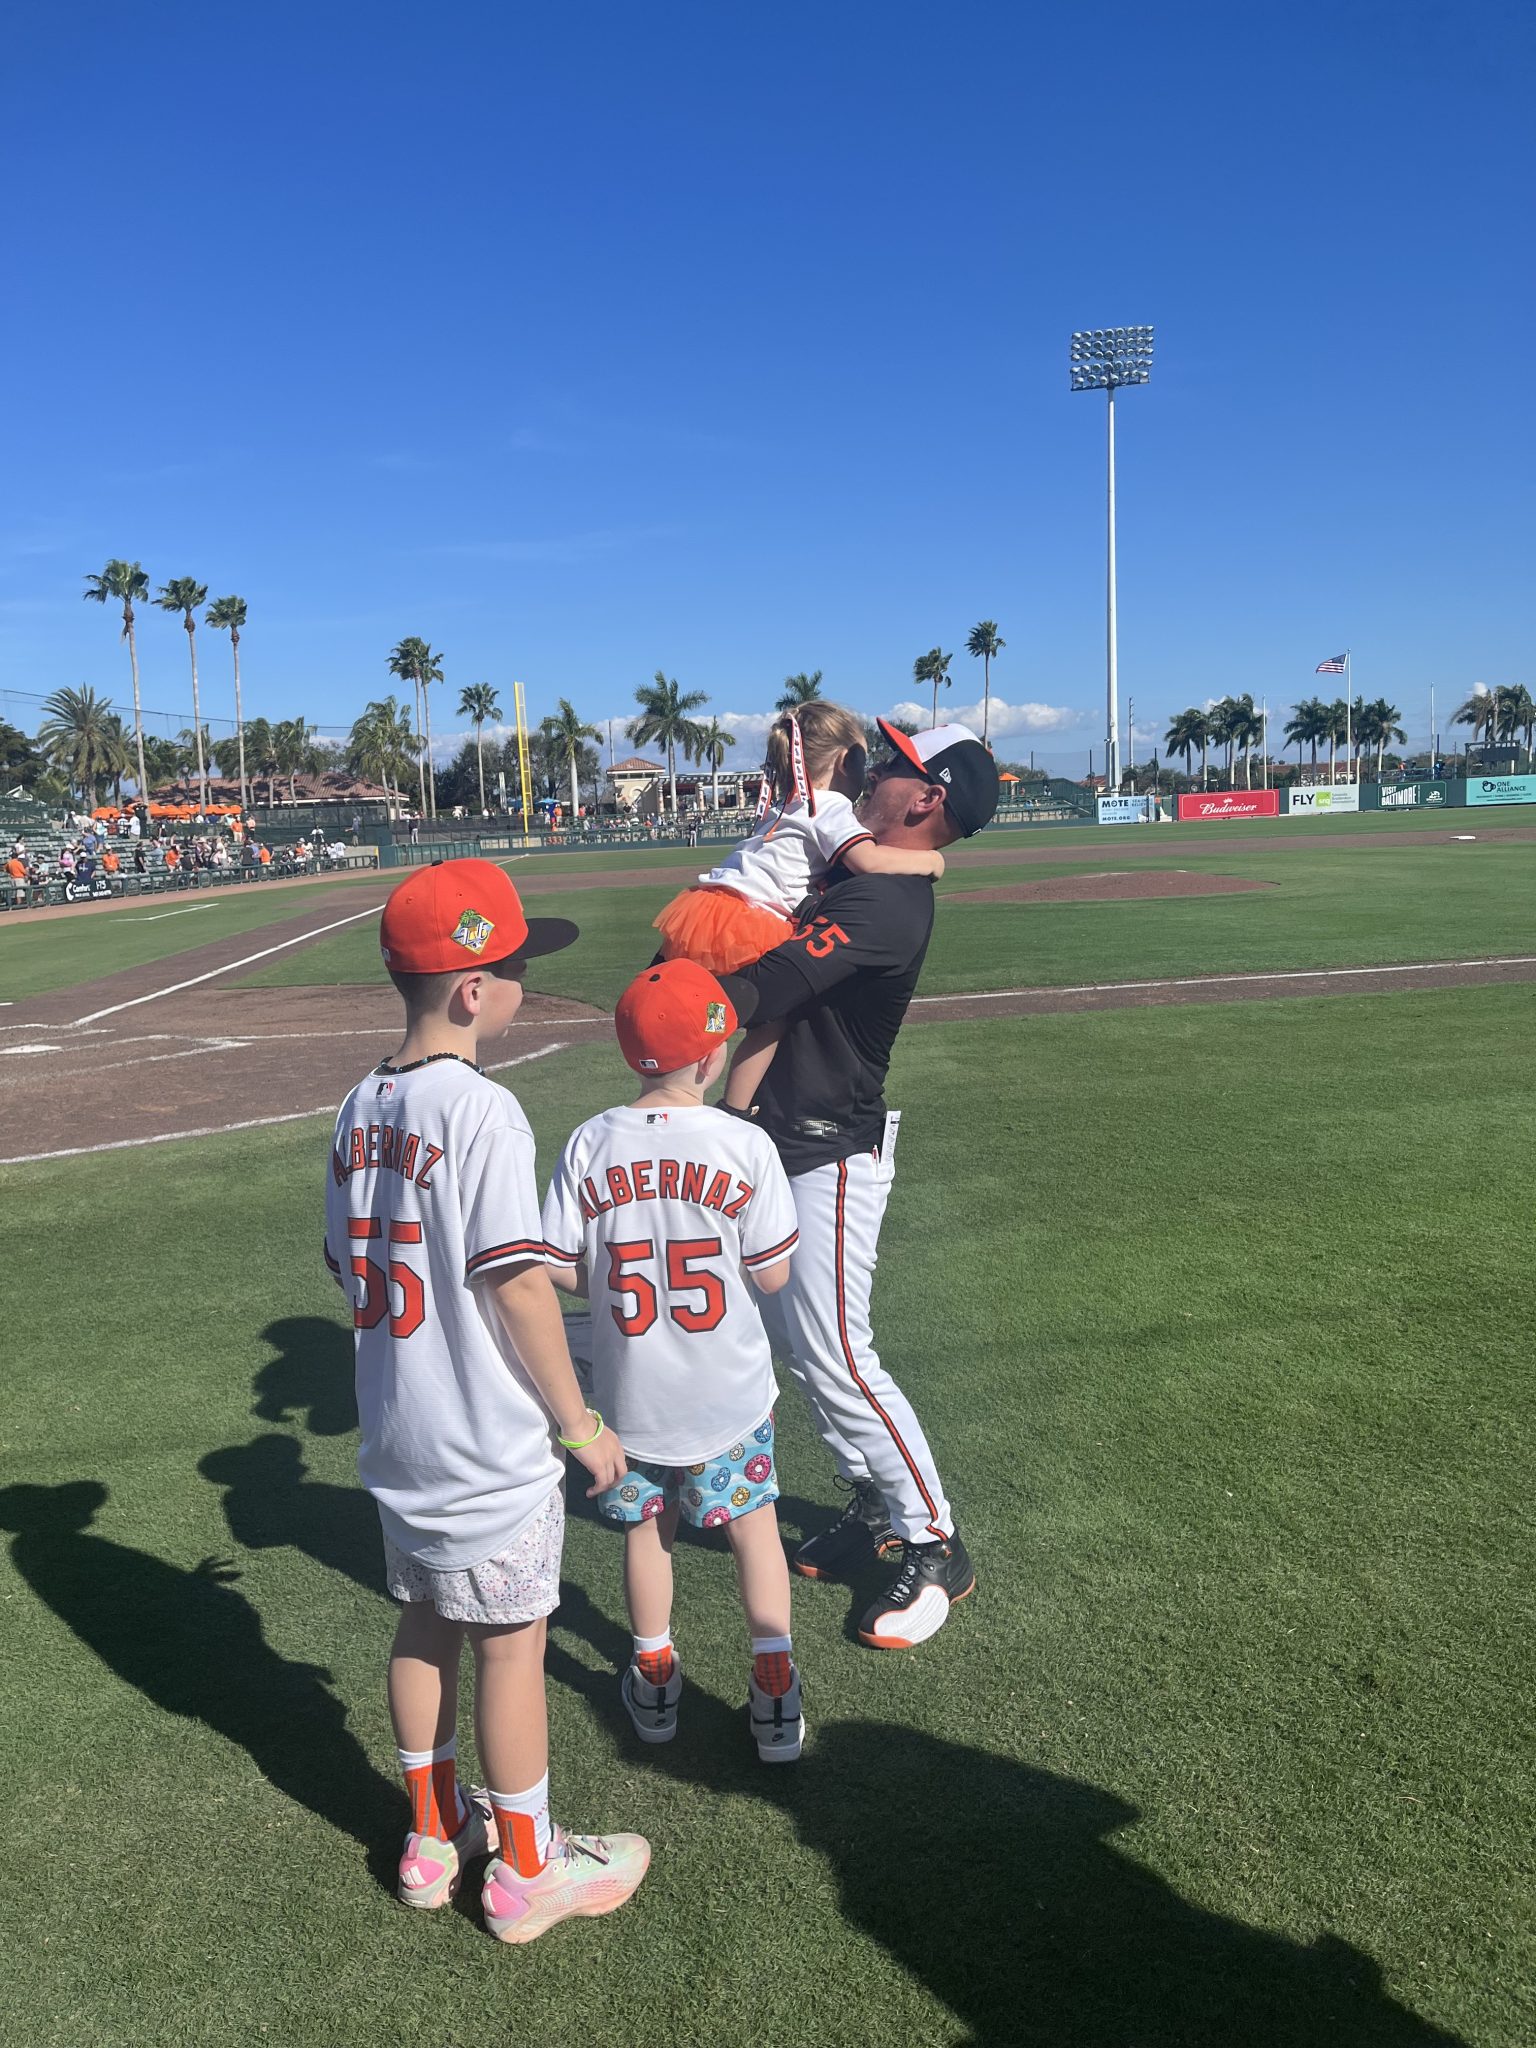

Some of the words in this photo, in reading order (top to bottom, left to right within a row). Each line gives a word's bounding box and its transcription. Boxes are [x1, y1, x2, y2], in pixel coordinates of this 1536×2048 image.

[1292, 794, 1315, 806] FLY
[1381, 785, 1397, 797] VISIT
[1381, 785, 1417, 806] BALTIMORE
[1102, 799, 1129, 808] MOTE
[1199, 803, 1258, 815] Budweiser
[332, 1124, 444, 1191] ALBERNAZ
[578, 1158, 753, 1225] ALBERNAZ
[347, 1216, 425, 1339] 55
[604, 1235, 727, 1337] 55
